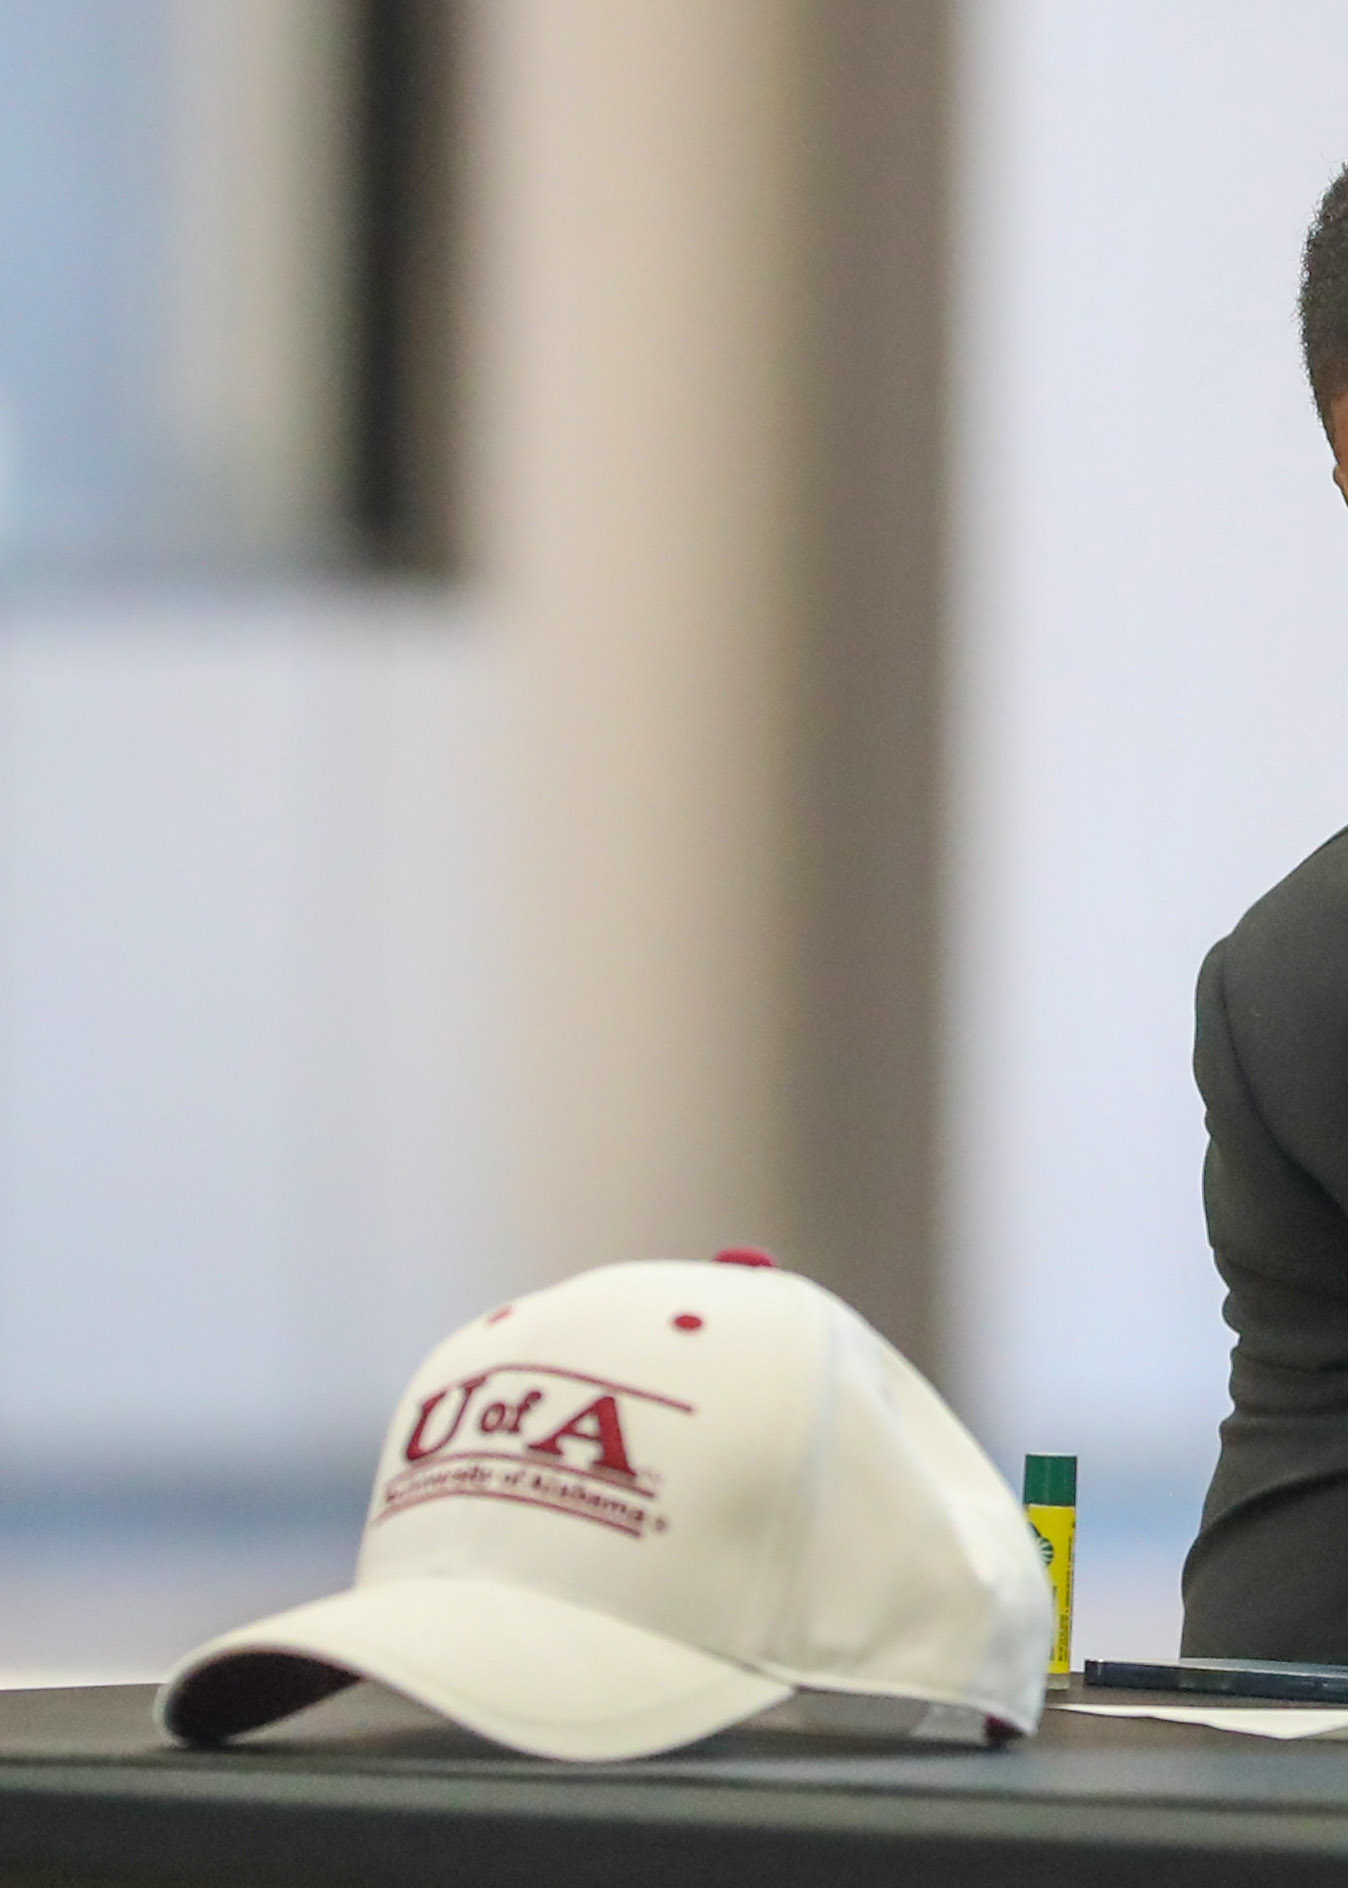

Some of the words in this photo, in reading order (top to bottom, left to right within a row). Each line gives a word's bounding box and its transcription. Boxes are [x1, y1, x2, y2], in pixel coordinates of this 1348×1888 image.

[405, 1376, 487, 1461] U
[480, 1391, 543, 1433] of
[526, 1396, 638, 1478] A
